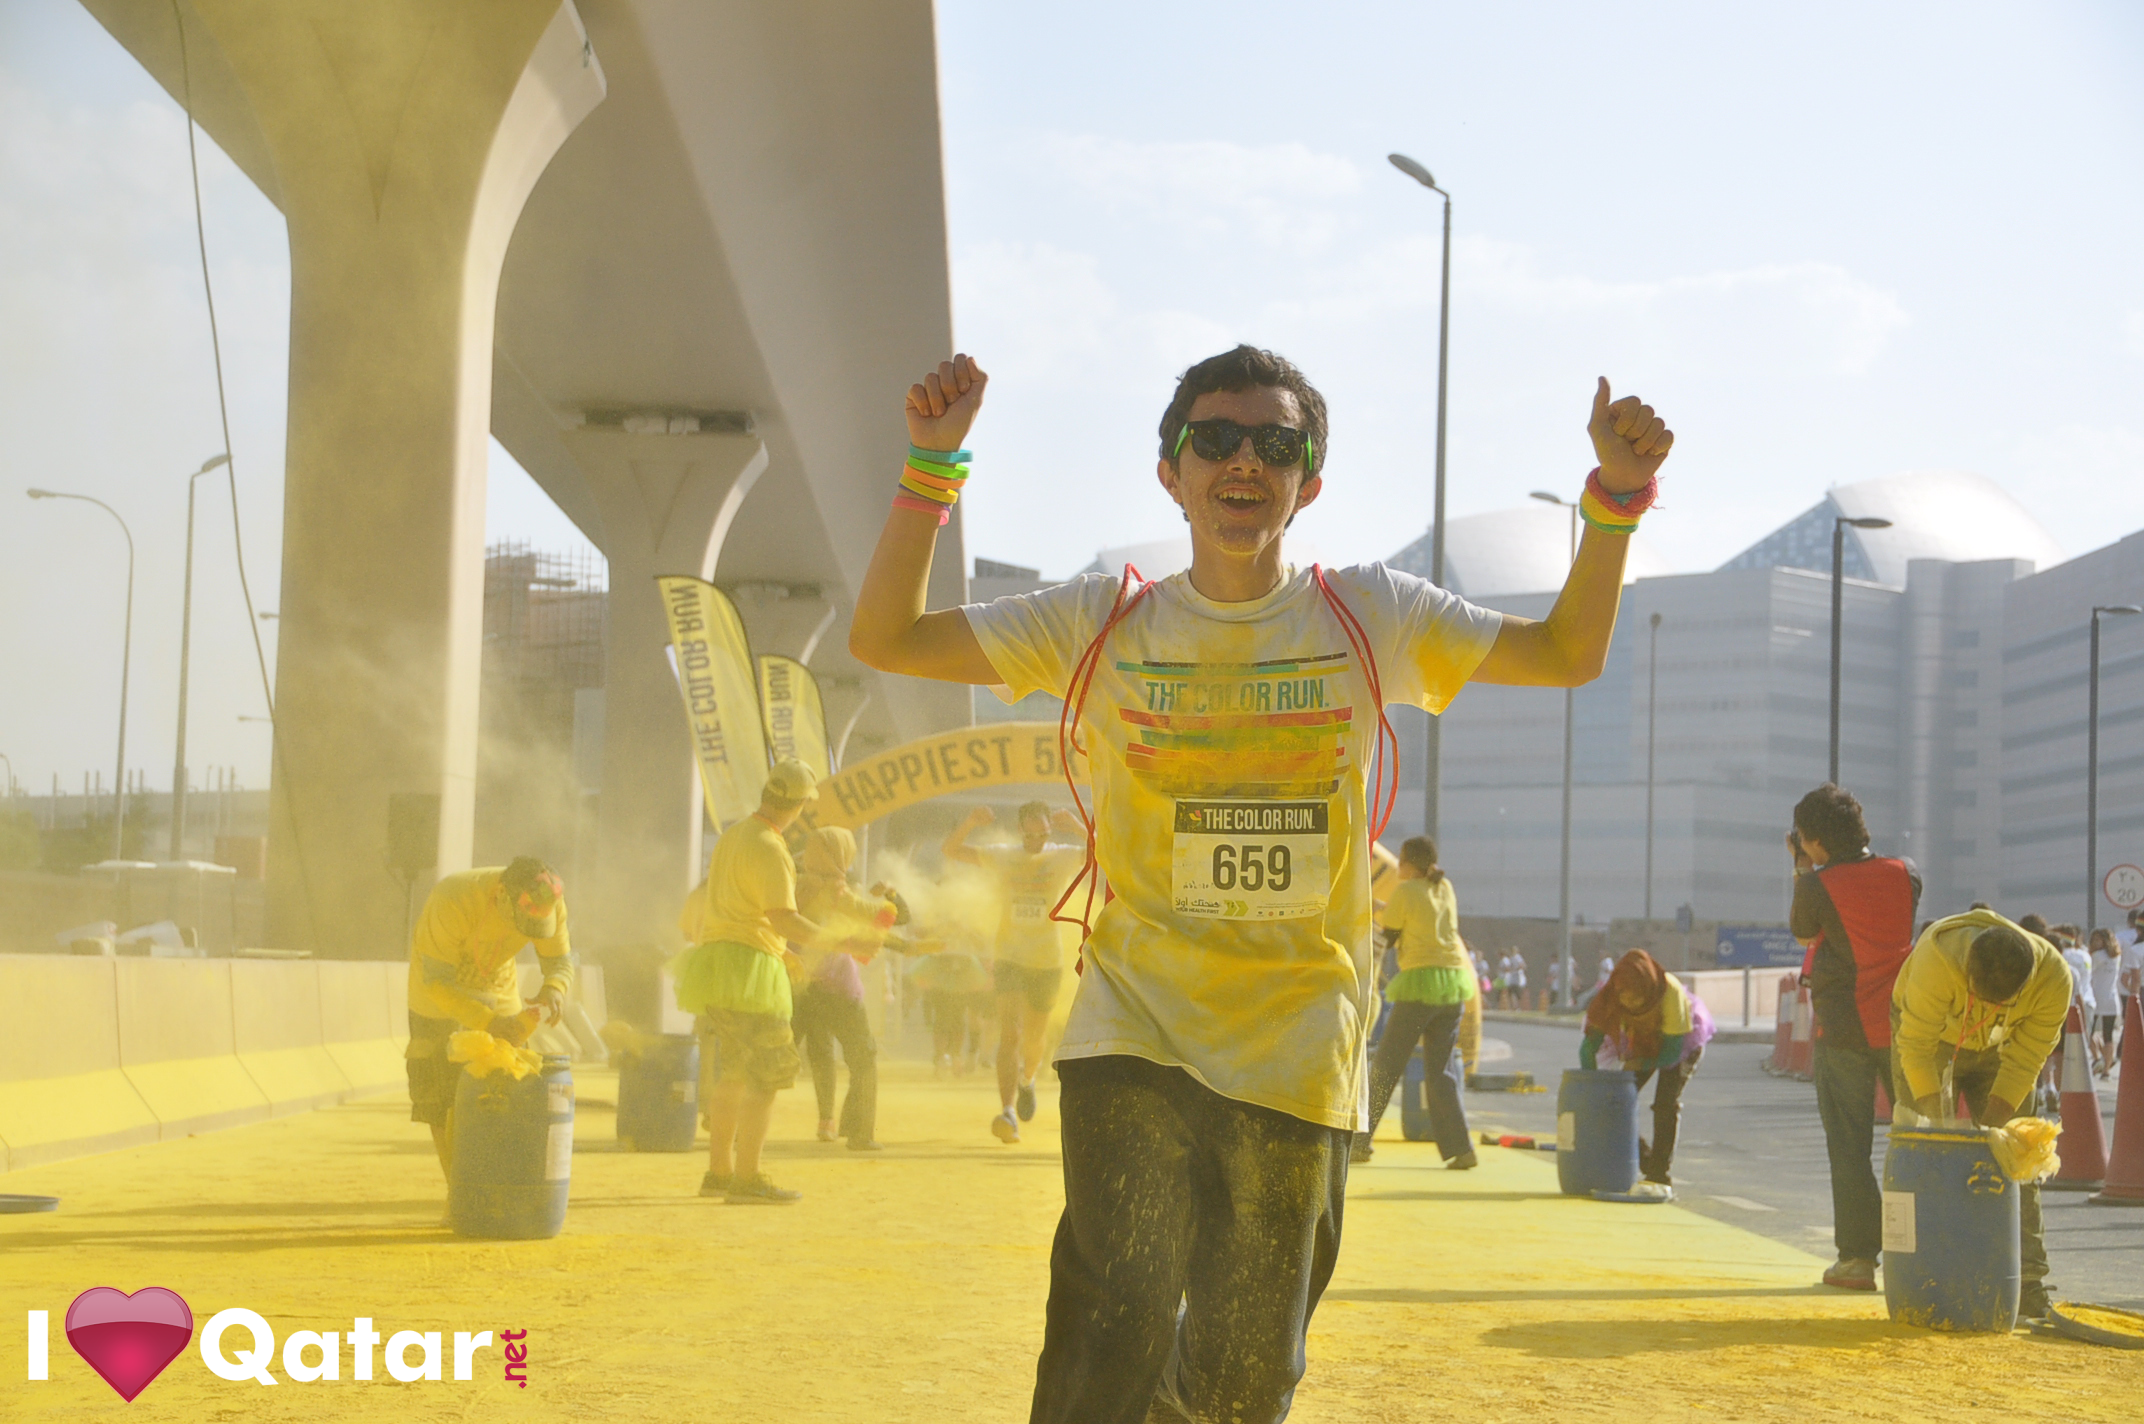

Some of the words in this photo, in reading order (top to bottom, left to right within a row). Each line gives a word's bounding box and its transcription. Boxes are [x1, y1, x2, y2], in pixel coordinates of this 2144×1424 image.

[1146, 682, 1188, 712] THE
[1193, 681, 1271, 713] COLOR
[831, 735, 1013, 817] HAPPIEST
[1033, 736, 1082, 777] 5K
[1203, 808, 1232, 830] THE
[1234, 808, 1281, 830] COLOR
[1211, 844, 1292, 892] 659
[2117, 888, 2136, 902] 20
